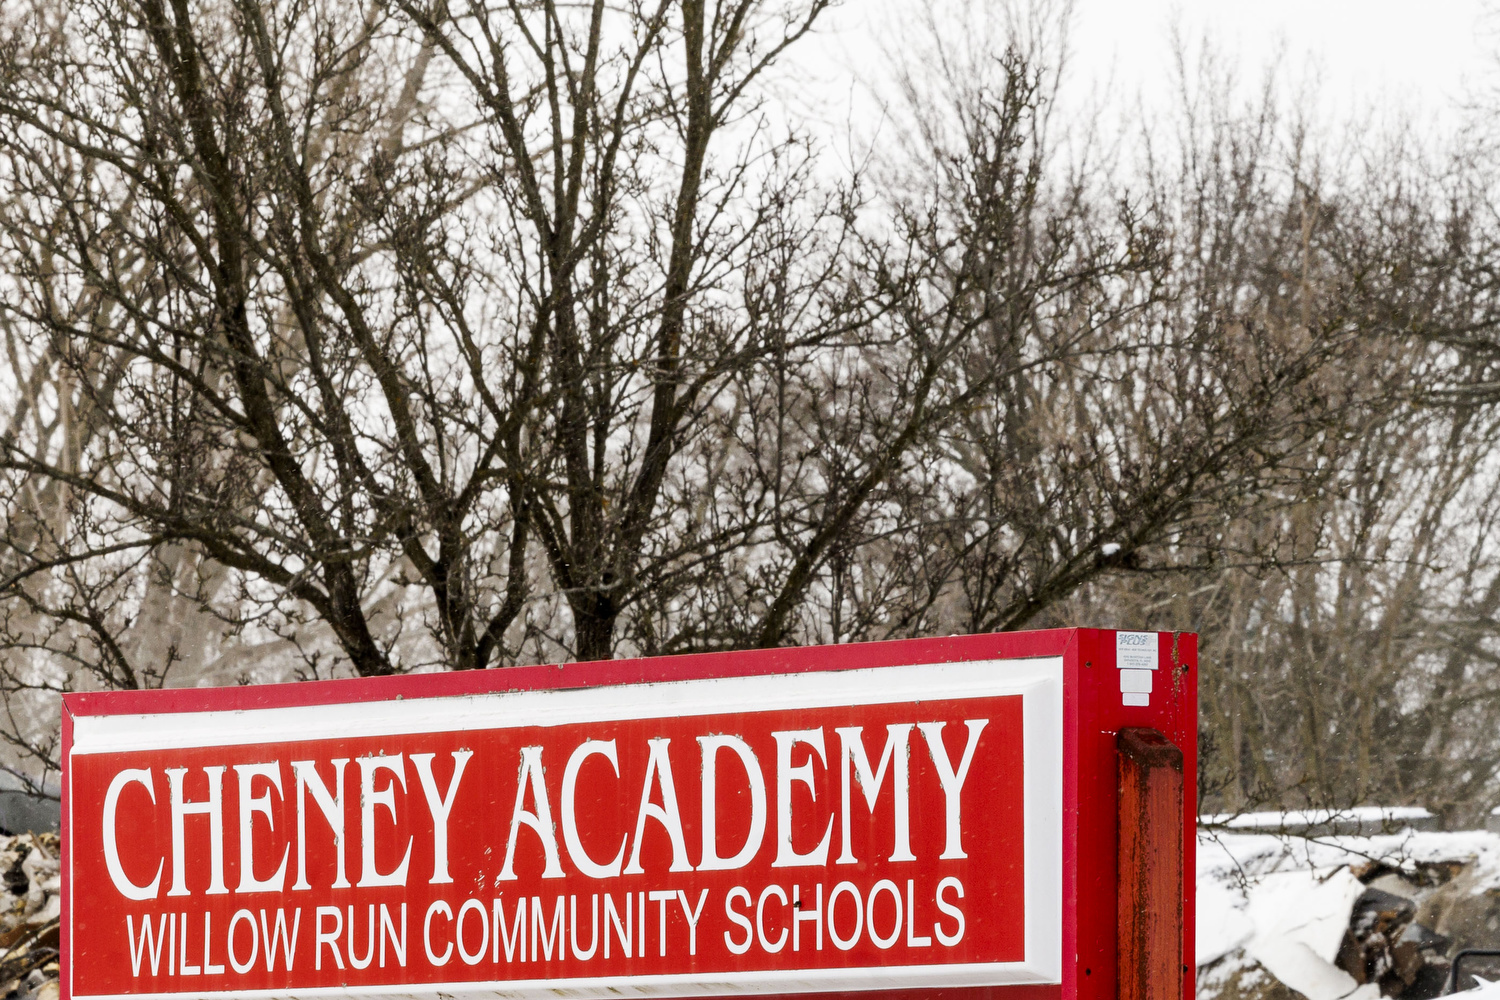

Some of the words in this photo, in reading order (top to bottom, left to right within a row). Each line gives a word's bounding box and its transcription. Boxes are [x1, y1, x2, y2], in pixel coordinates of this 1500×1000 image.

[102, 745, 473, 901] CHENEY
[494, 718, 990, 882] ACADEMY
[126, 906, 302, 978] WILLOW
[314, 901, 408, 972] RUN
[423, 887, 710, 967] COMMUNITY
[723, 876, 967, 955] SCHOOLS
